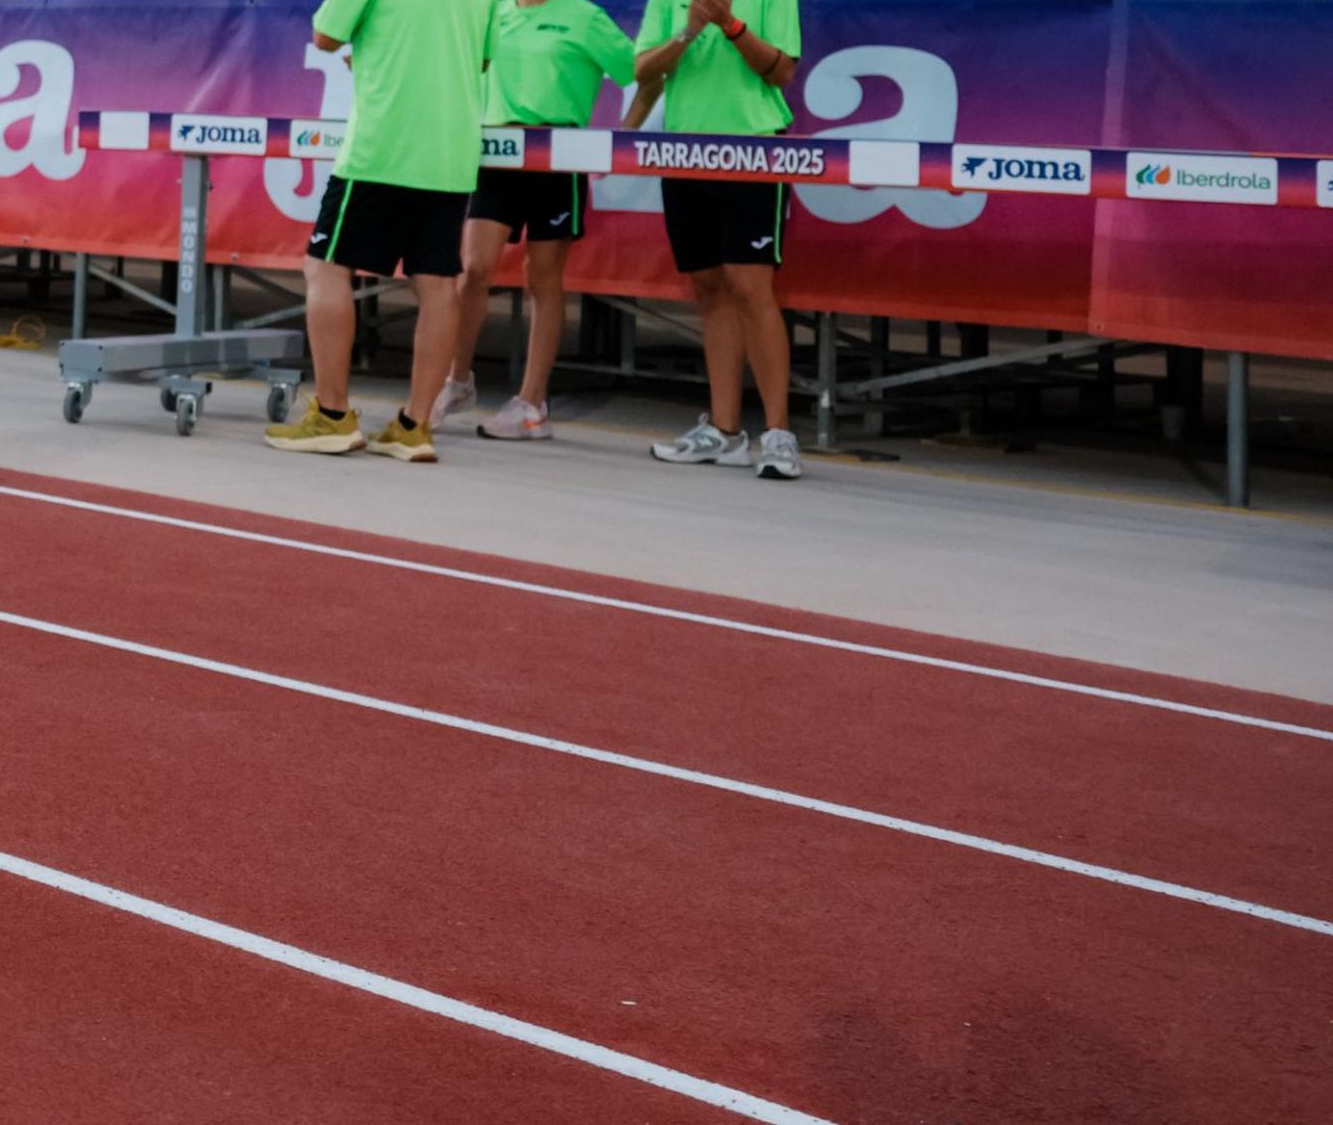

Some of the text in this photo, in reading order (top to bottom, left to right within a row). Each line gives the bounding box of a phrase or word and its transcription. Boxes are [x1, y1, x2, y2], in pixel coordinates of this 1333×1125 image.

[634, 140, 825, 174] TARRAGONA 2025
[1176, 169, 1271, 191] Iberdrola
[182, 221, 198, 293] MONDO
